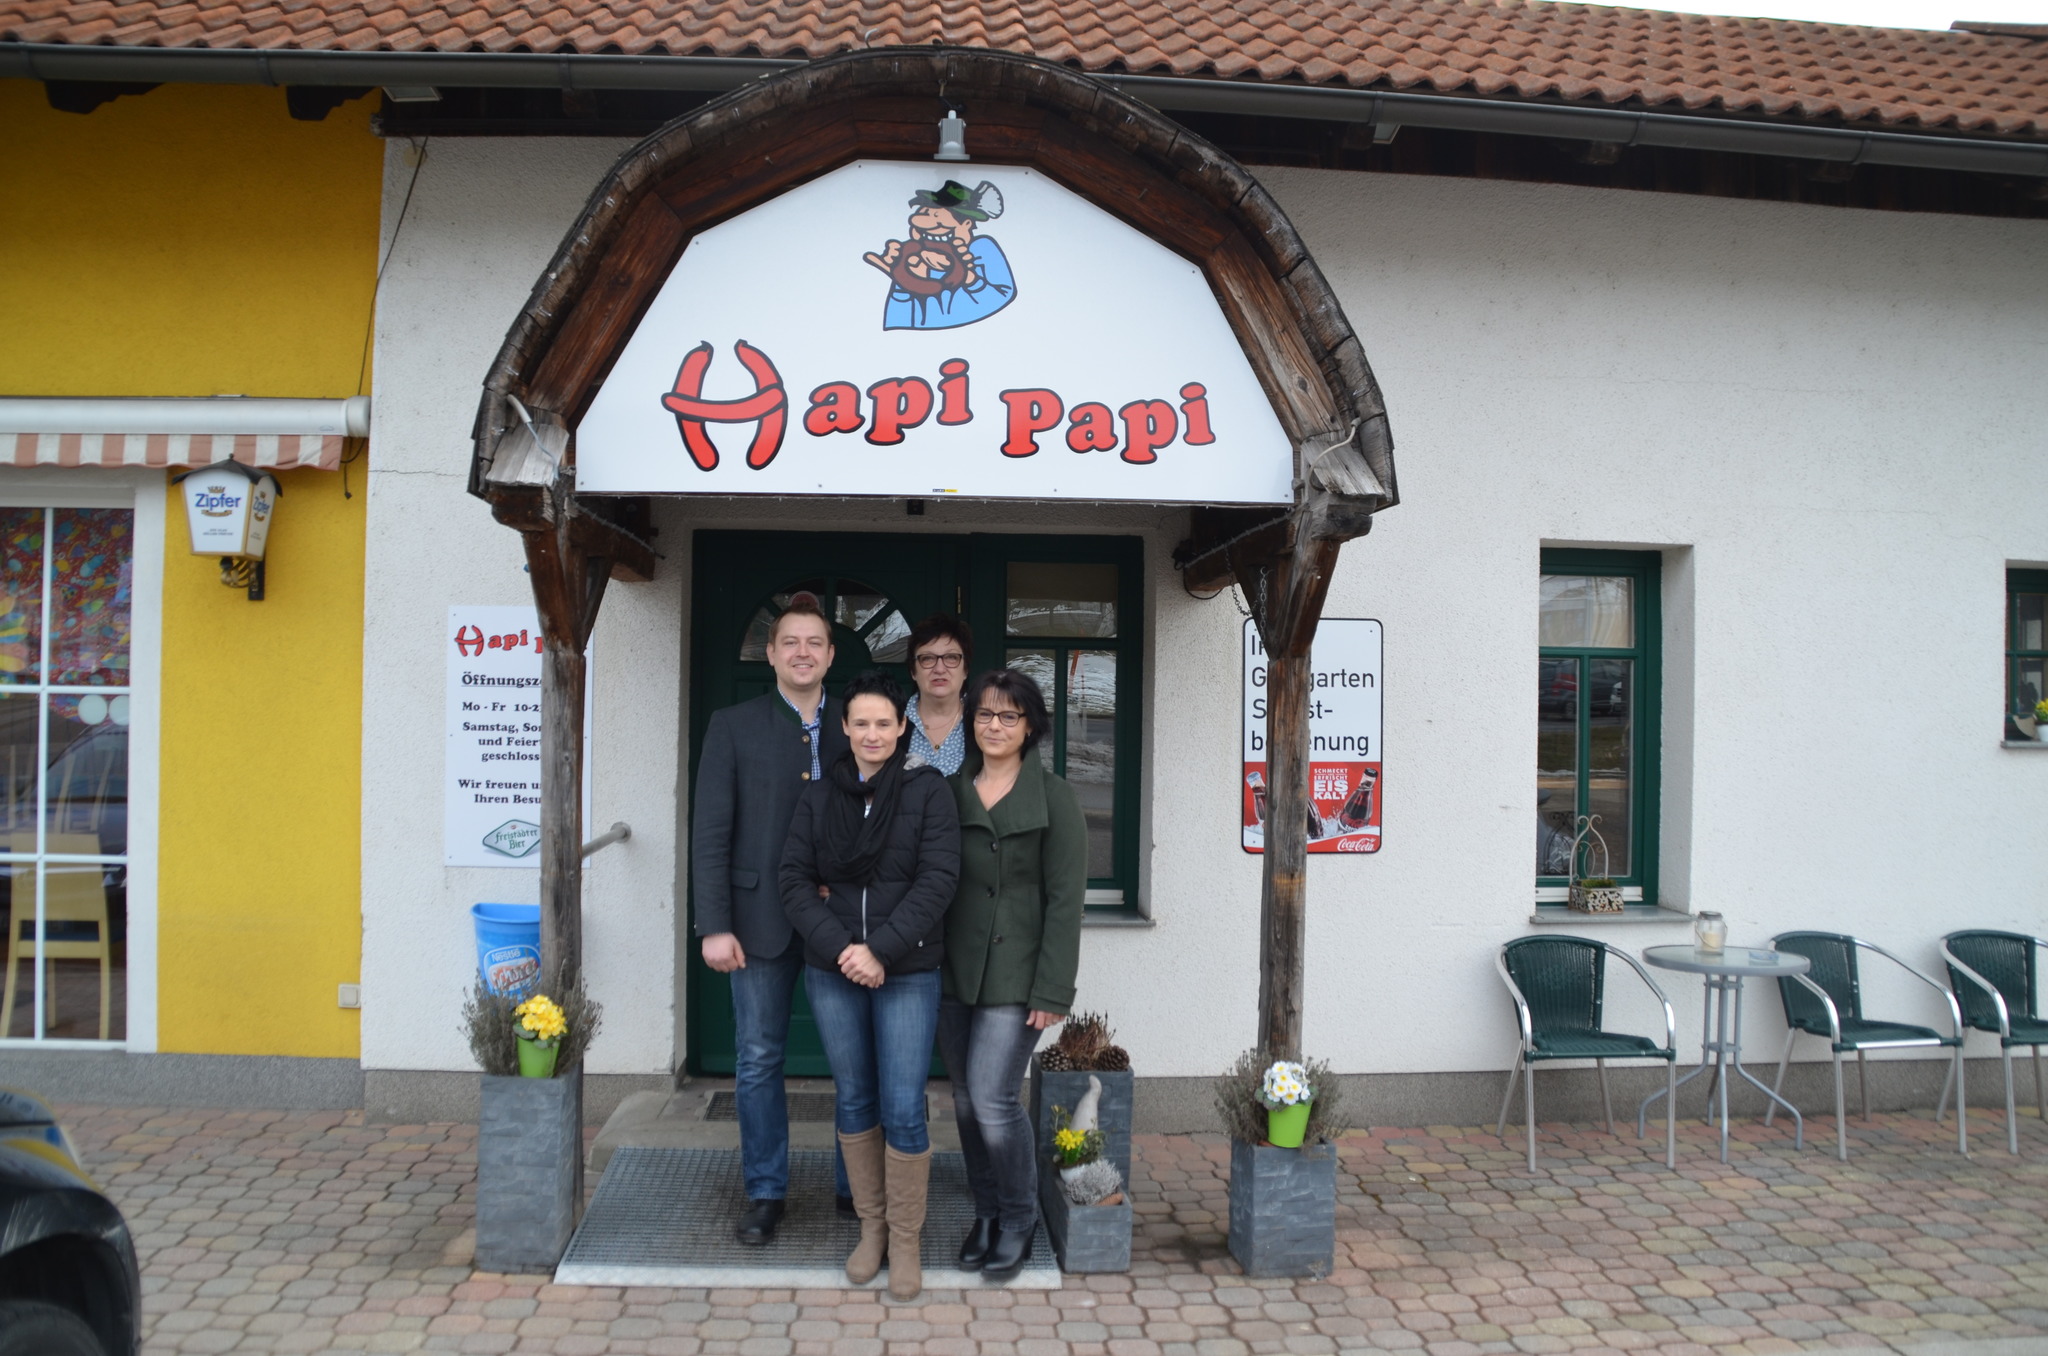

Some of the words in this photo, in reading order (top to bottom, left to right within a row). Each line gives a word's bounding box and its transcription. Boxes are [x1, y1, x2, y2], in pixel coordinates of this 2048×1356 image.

[661, 339, 973, 471] Hapi
[999, 381, 1216, 464] Papi
[195, 493, 241, 511] Zipfer
[454, 625, 528, 657] Hapi
[461, 671, 541, 688] Öffnungsz
[462, 702, 480, 711] Mo
[491, 702, 506, 712] Fr
[514, 704, 541, 712] 10-2
[462, 722, 519, 733] Samstag,
[478, 737, 502, 746] und
[506, 737, 541, 746] Feier
[481, 752, 540, 762] geschloss
[458, 779, 481, 789] Wir
[485, 780, 527, 790] freuen
[1314, 780, 1348, 792] EIS
[474, 794, 509, 804] Ihren
[513, 795, 541, 804] Besu
[1314, 792, 1347, 800] KALT
[508, 839, 525, 850] Bier
